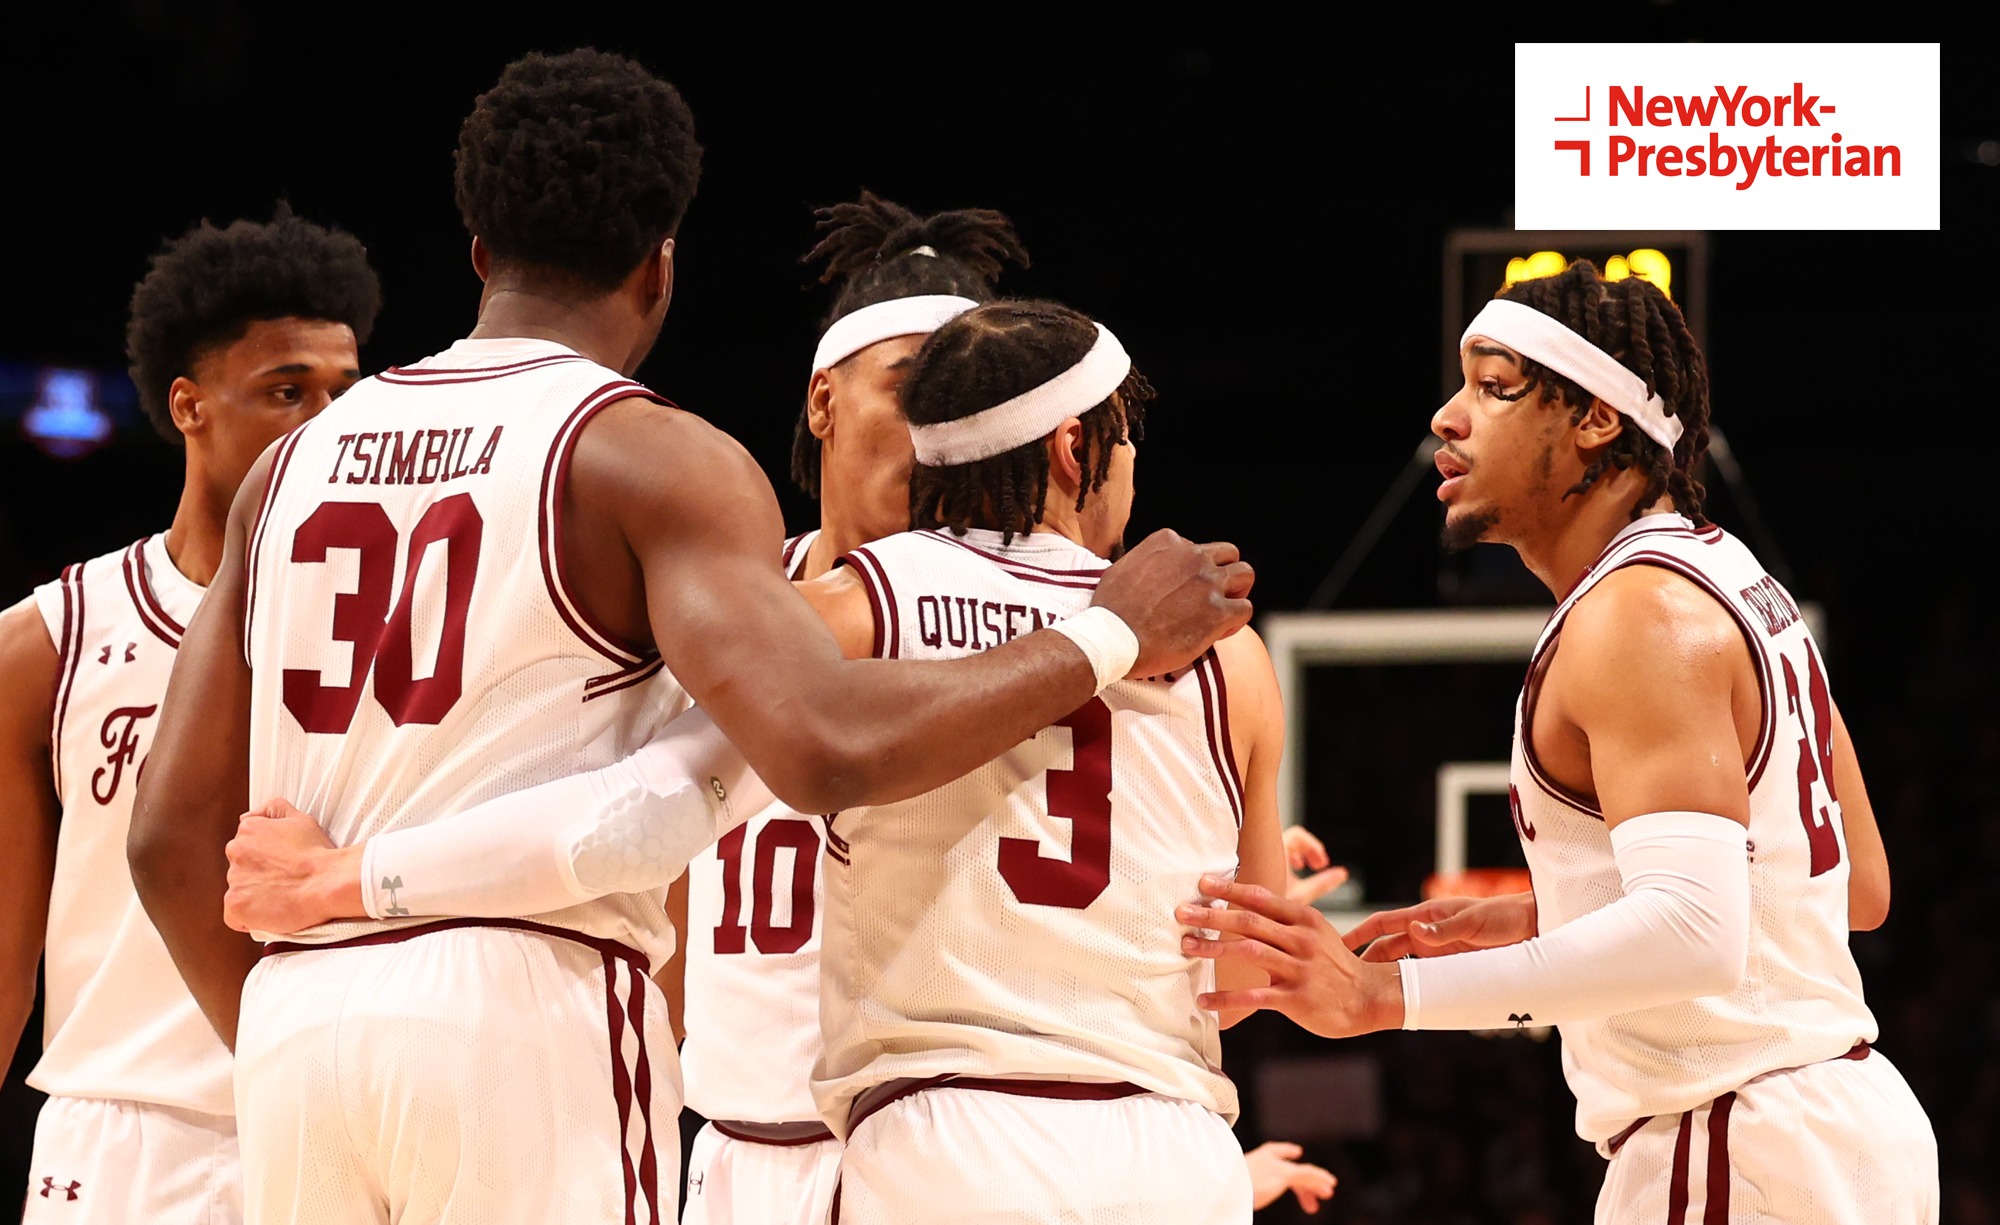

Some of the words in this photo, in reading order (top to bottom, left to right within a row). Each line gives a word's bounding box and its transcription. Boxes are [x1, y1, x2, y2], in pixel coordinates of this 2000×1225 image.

[328, 425, 504, 485] TSIMBILA
[282, 493, 484, 733] 30
[713, 818, 821, 955] 10
[997, 693, 1113, 910] 3
